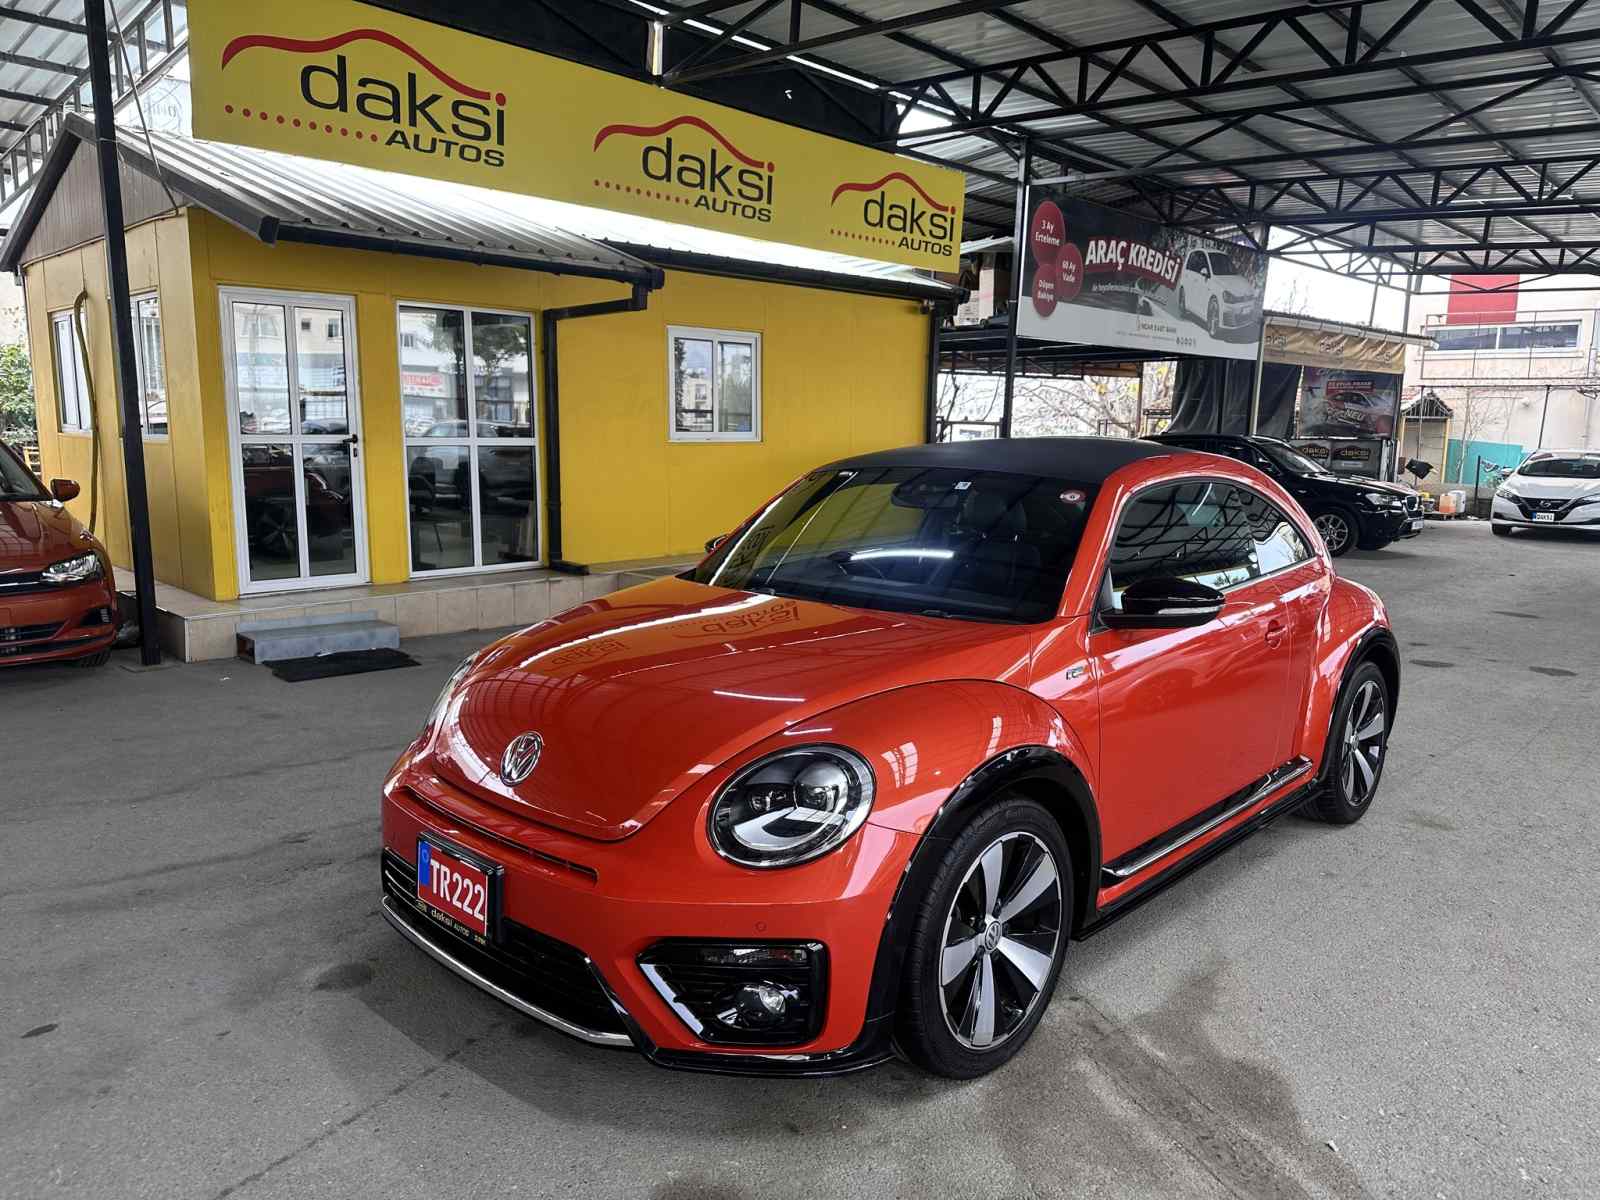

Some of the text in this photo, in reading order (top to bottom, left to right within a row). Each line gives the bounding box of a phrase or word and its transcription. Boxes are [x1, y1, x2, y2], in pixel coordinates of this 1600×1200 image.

[301, 55, 507, 147] daksi
[384, 129, 505, 168] AUTOS
[642, 137, 776, 206] daksi
[694, 194, 772, 223] AUTOS
[863, 190, 956, 243] daksi
[1041, 220, 1046, 230] 3
[898, 236, 953, 257] AUTOS
[1085, 239, 1180, 283] ARAÇ KREDİSİ
[430, 859, 485, 922] TR222
